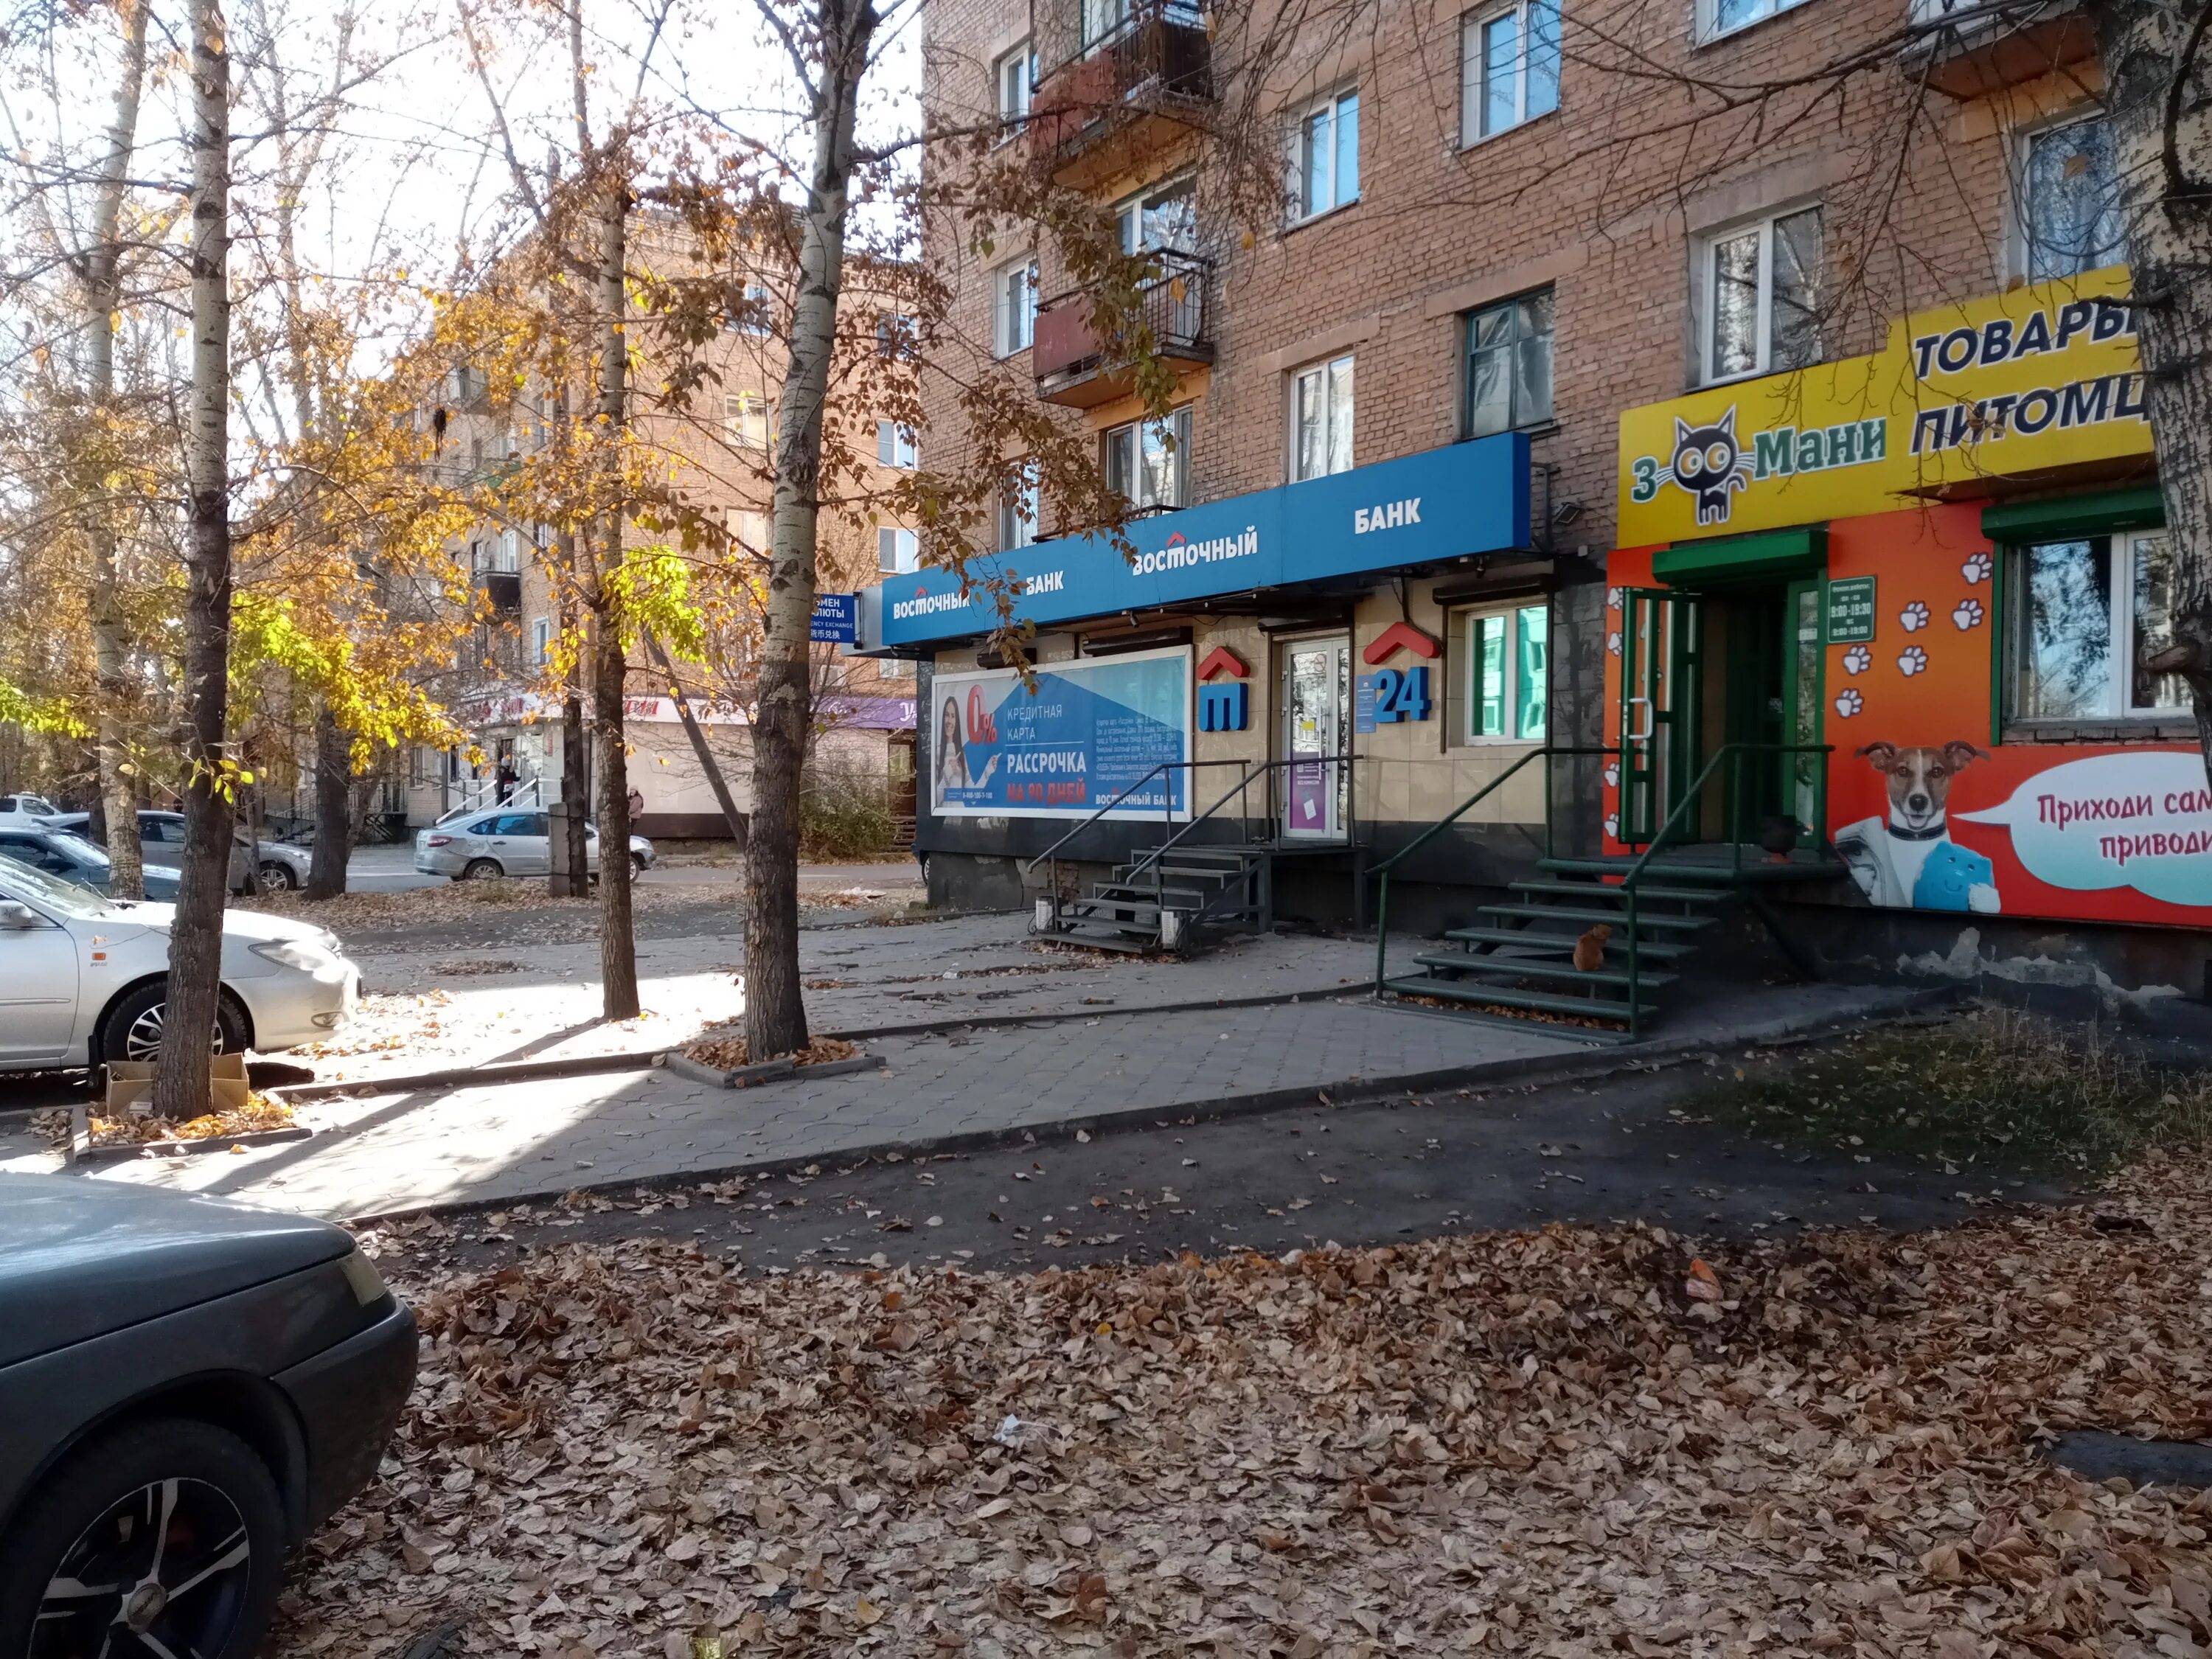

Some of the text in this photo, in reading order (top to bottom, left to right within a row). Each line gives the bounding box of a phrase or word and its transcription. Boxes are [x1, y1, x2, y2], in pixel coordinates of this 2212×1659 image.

[1753, 417, 1887, 481] Мани
[1354, 497, 1422, 535] БАНК
[1026, 571, 1064, 596] БАНК
[1376, 667, 1430, 723] 24
[967, 684, 998, 745] 0%
[1007, 704, 1062, 723] КРЕДИТНАЯ
[1007, 727, 1035, 741] КАРТА
[1007, 751, 1087, 773] РАССРОЧКА
[1006, 777, 1086, 806] НА 90 ДНЕЙ
[2037, 794, 2154, 832] Приходи
